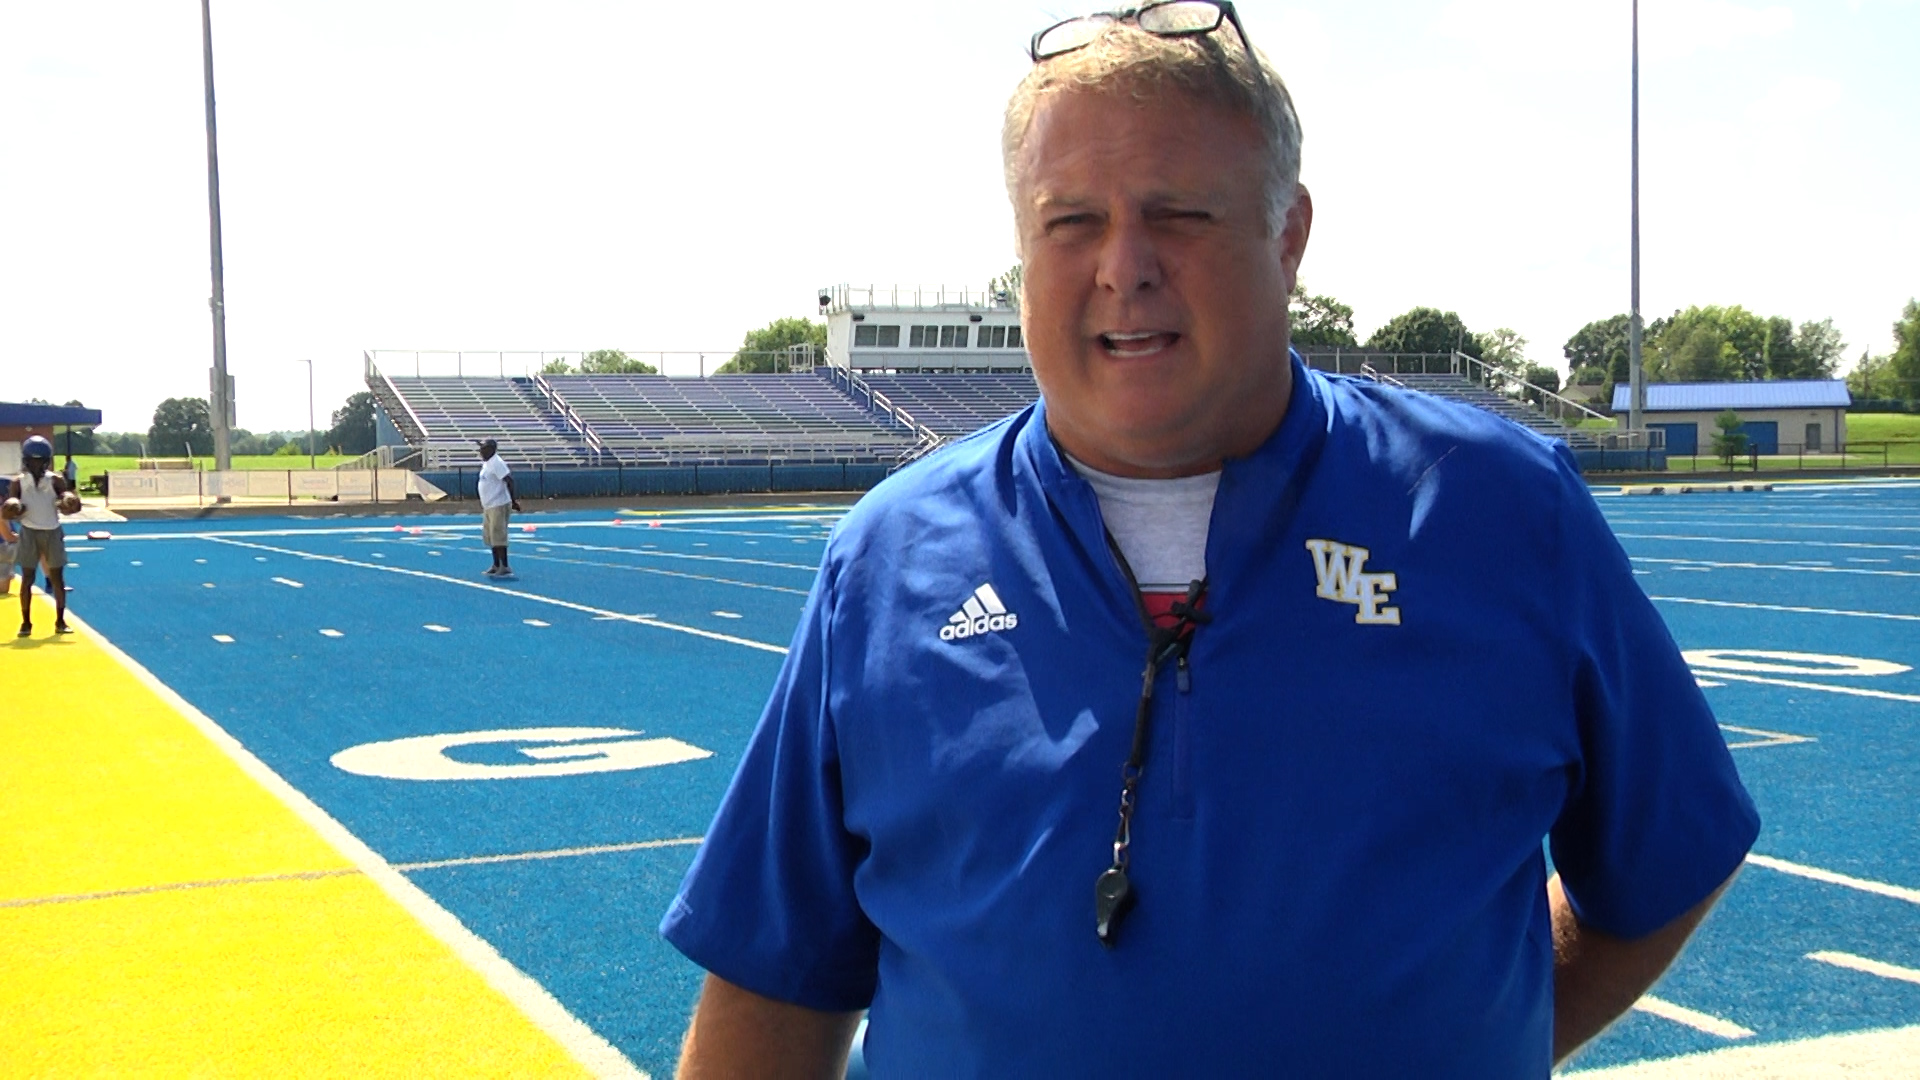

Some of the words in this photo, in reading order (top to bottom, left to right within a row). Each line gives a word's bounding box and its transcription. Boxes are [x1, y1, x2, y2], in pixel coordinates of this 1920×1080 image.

[1305, 539, 1400, 625] WE
[939, 612, 1018, 641] adidas
[329, 726, 714, 780] G
